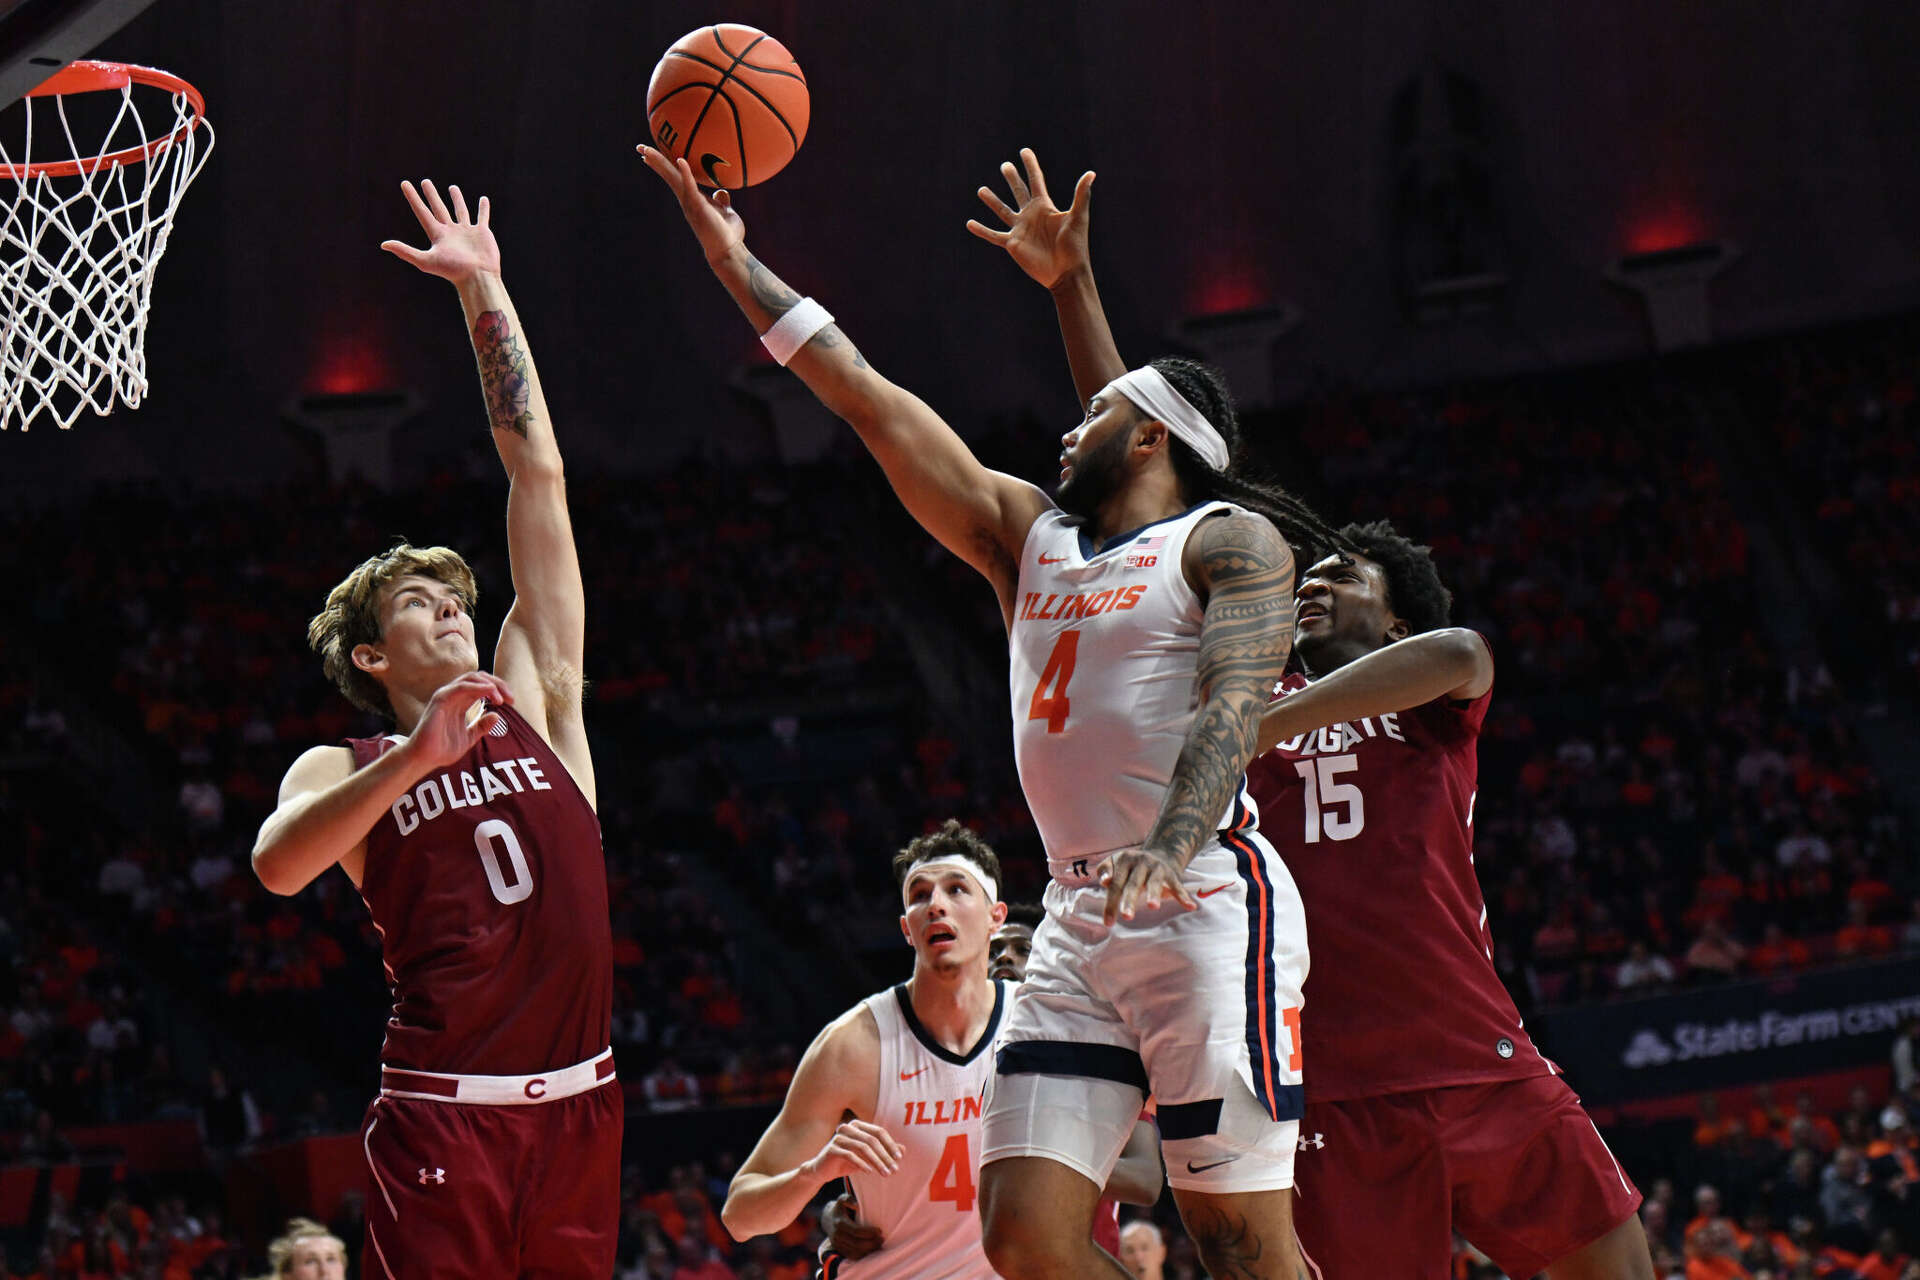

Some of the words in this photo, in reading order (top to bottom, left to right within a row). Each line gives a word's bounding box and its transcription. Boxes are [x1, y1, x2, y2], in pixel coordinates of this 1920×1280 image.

[1020, 585, 1147, 621] ILLINOIS
[1028, 630, 1080, 733] 4
[392, 757, 552, 836] COLGATE
[1294, 754, 1364, 843] 15
[474, 819, 533, 905] 0
[524, 1078, 546, 1100] C
[929, 1133, 976, 1212] 4
